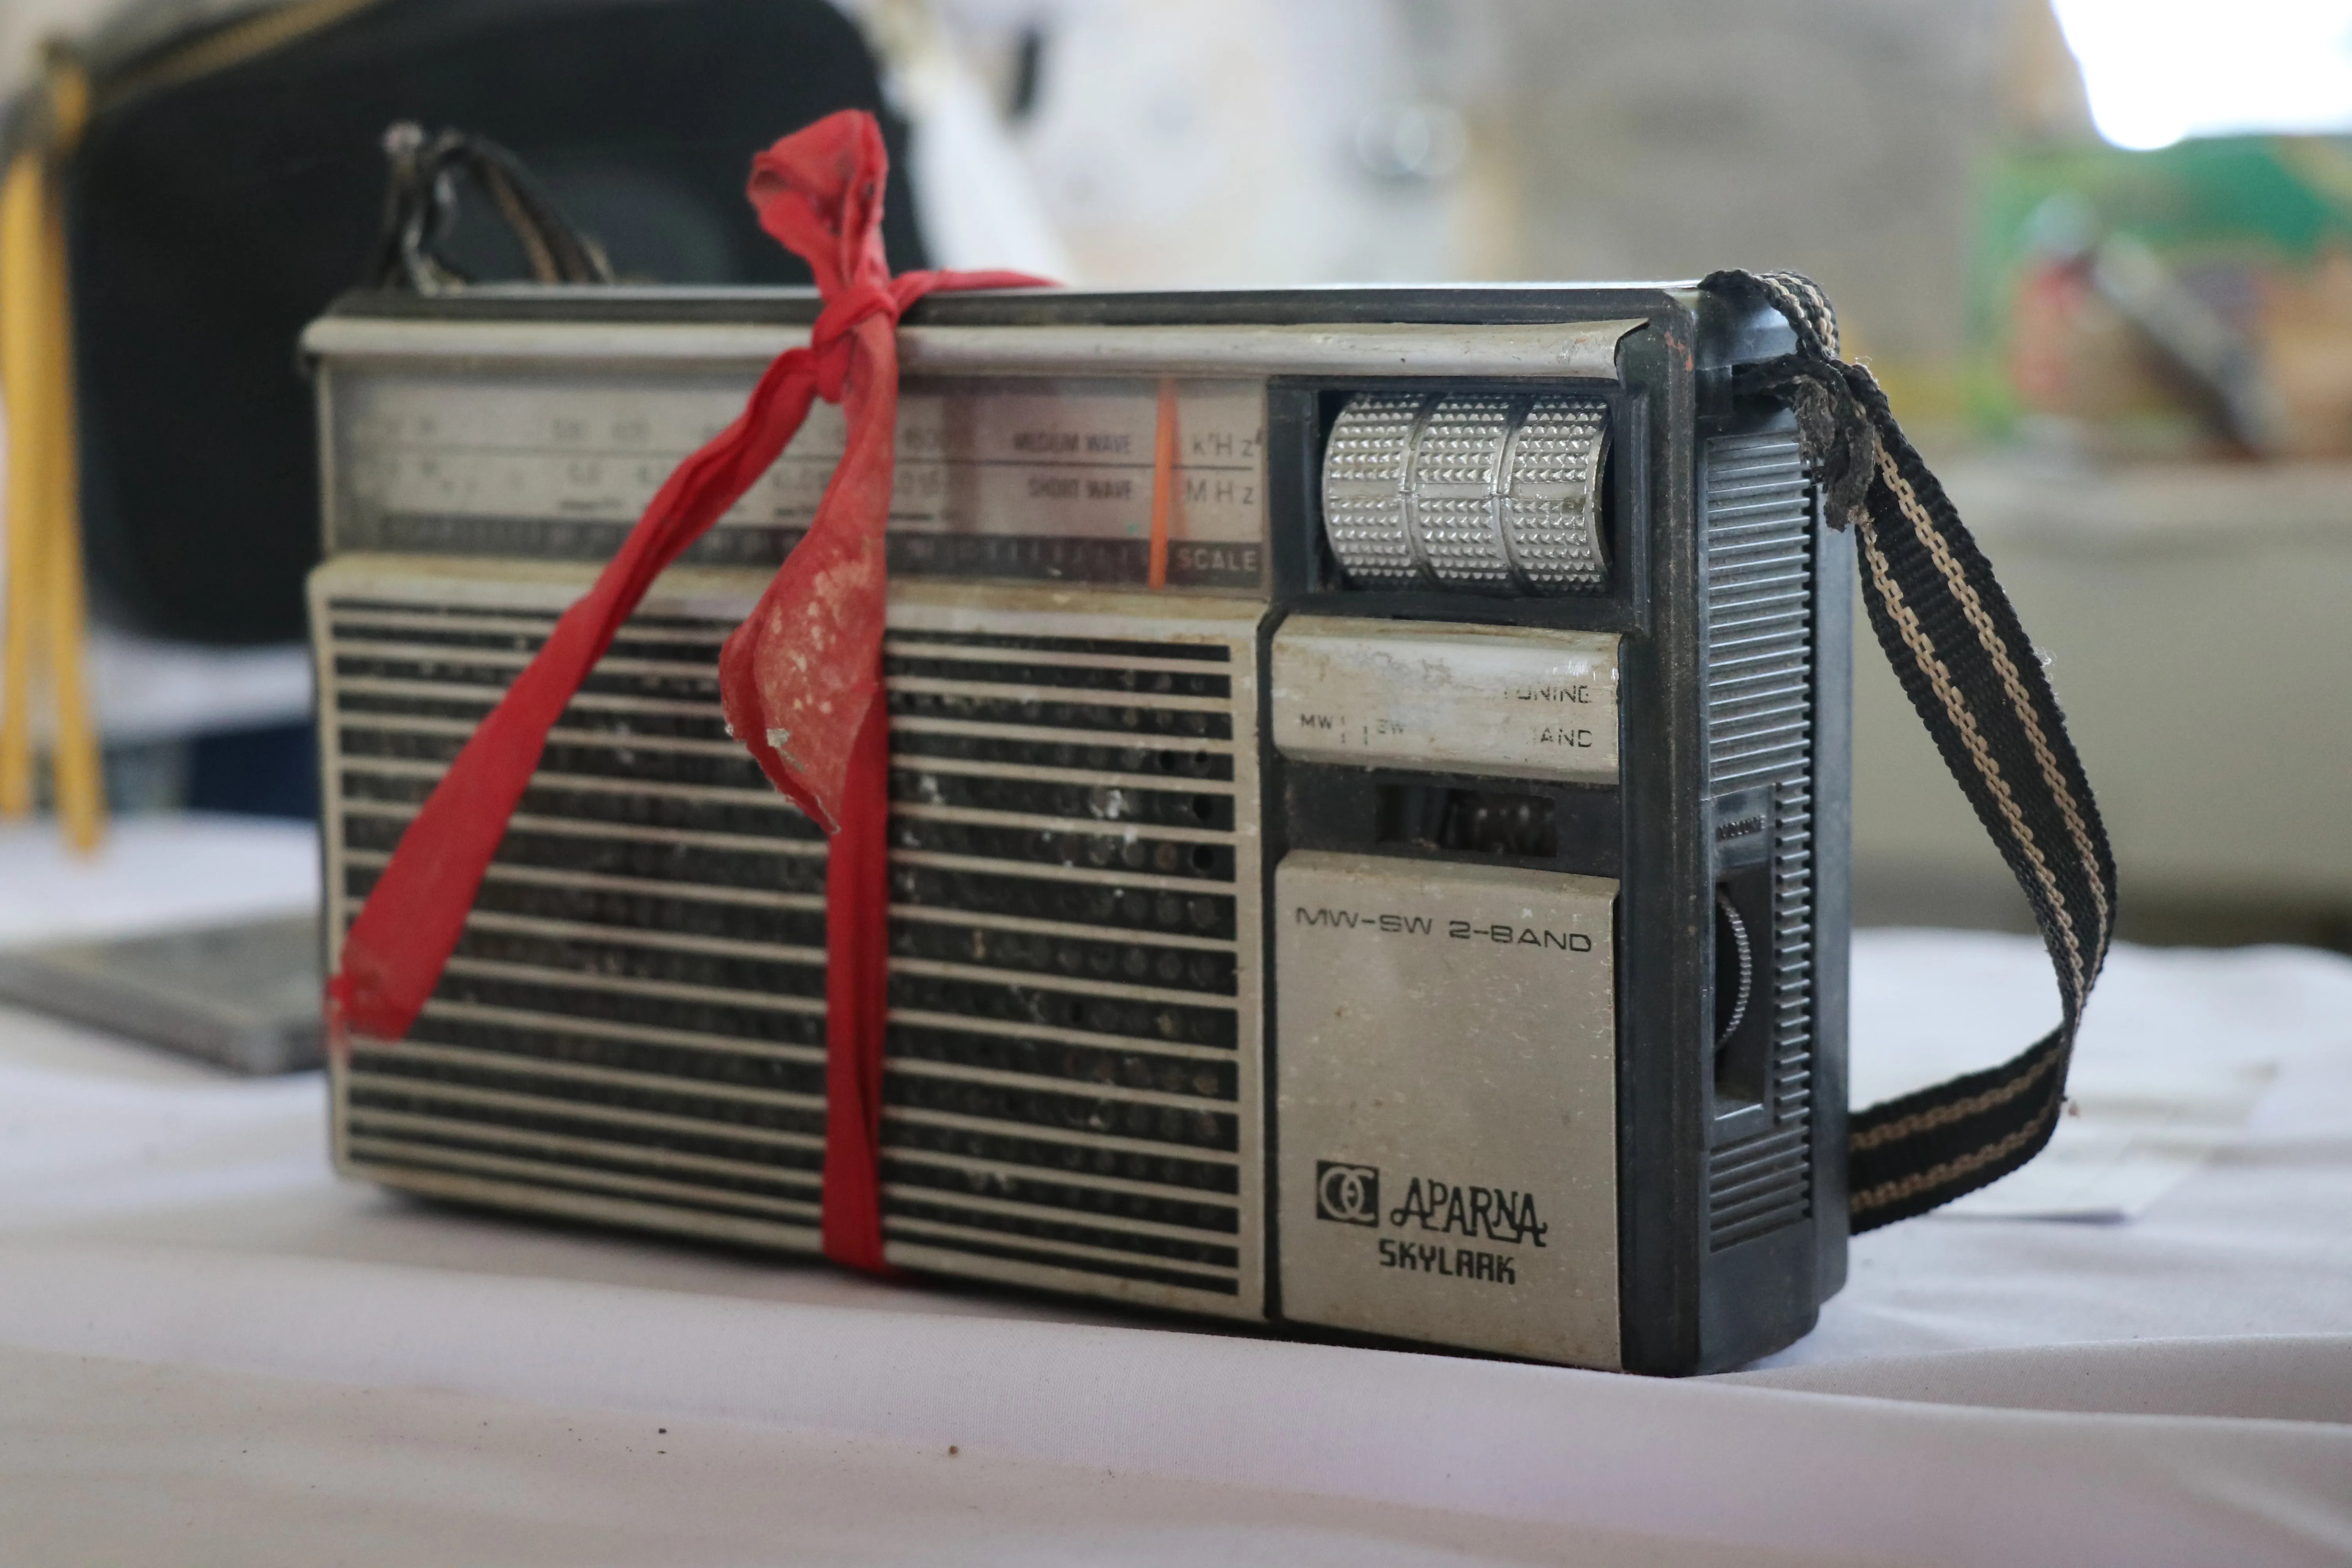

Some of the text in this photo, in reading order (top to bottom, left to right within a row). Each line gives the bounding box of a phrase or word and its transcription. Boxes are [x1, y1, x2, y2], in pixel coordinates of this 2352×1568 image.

[1086, 434, 1132, 455] WAVE
[1086, 479, 1132, 501] WAVE
[1178, 548, 1258, 572] SCALE
[1300, 713, 1333, 729] MW
[1296, 907, 1592, 952] MW-SW 2-BAND
[1390, 1176, 1548, 1248] APARNA
[1378, 1237, 1516, 1285] SKYLARK
